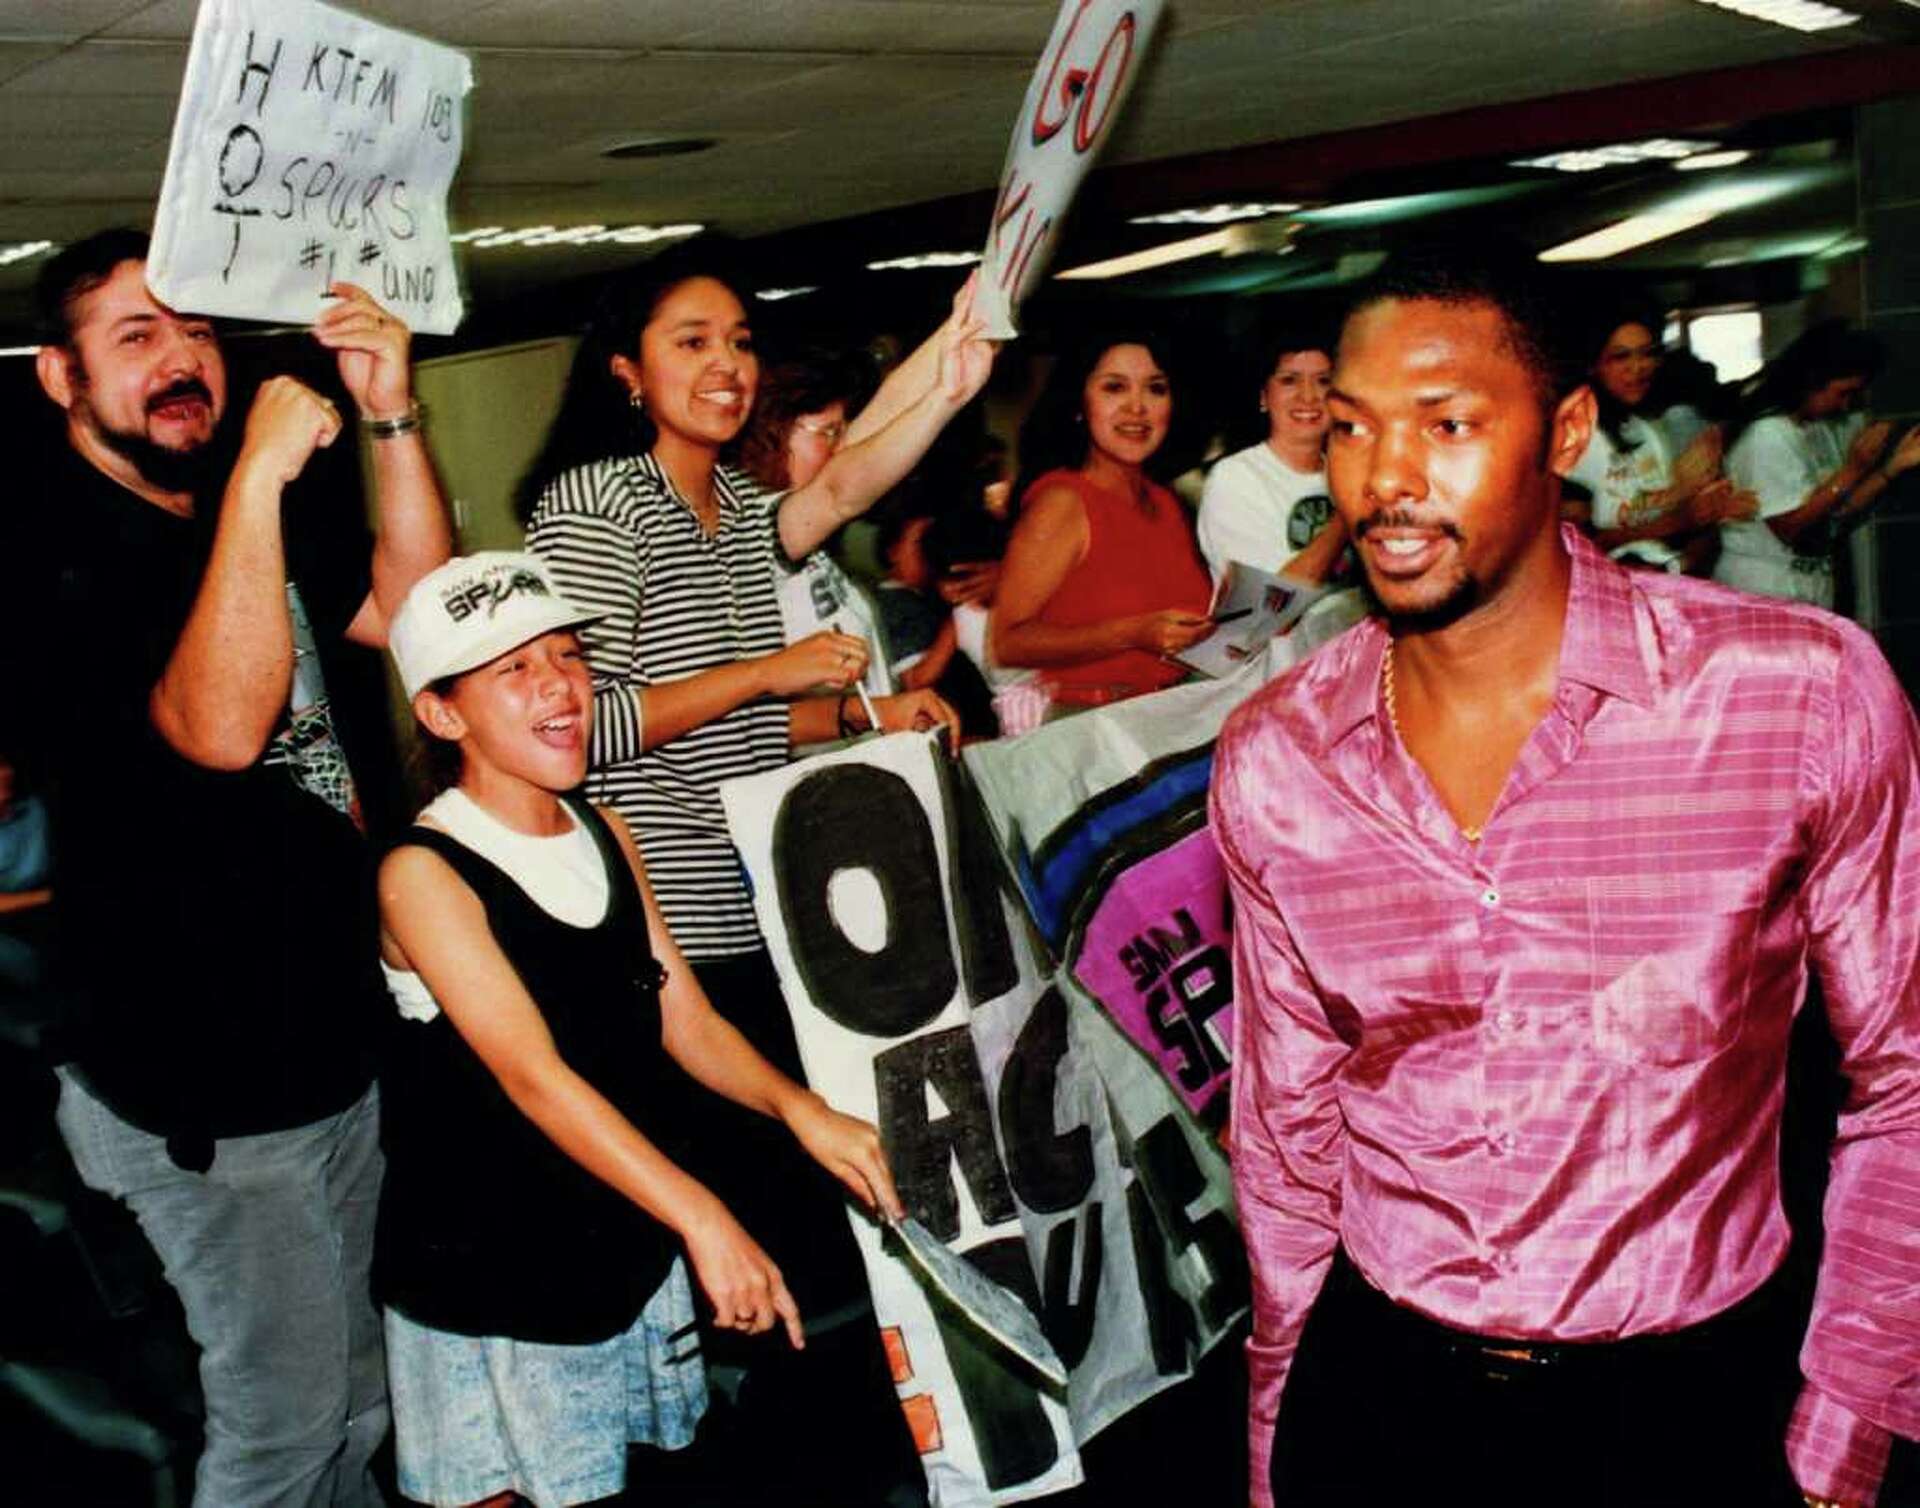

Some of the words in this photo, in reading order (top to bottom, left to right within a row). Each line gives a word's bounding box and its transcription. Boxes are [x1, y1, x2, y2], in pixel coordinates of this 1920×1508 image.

[302, 42, 398, 125] KTFM
[1031, 0, 1136, 153] GO
[212, 30, 283, 286] HOT
[271, 156, 416, 240] SPURS
[1146, 942, 1234, 1093] SP
